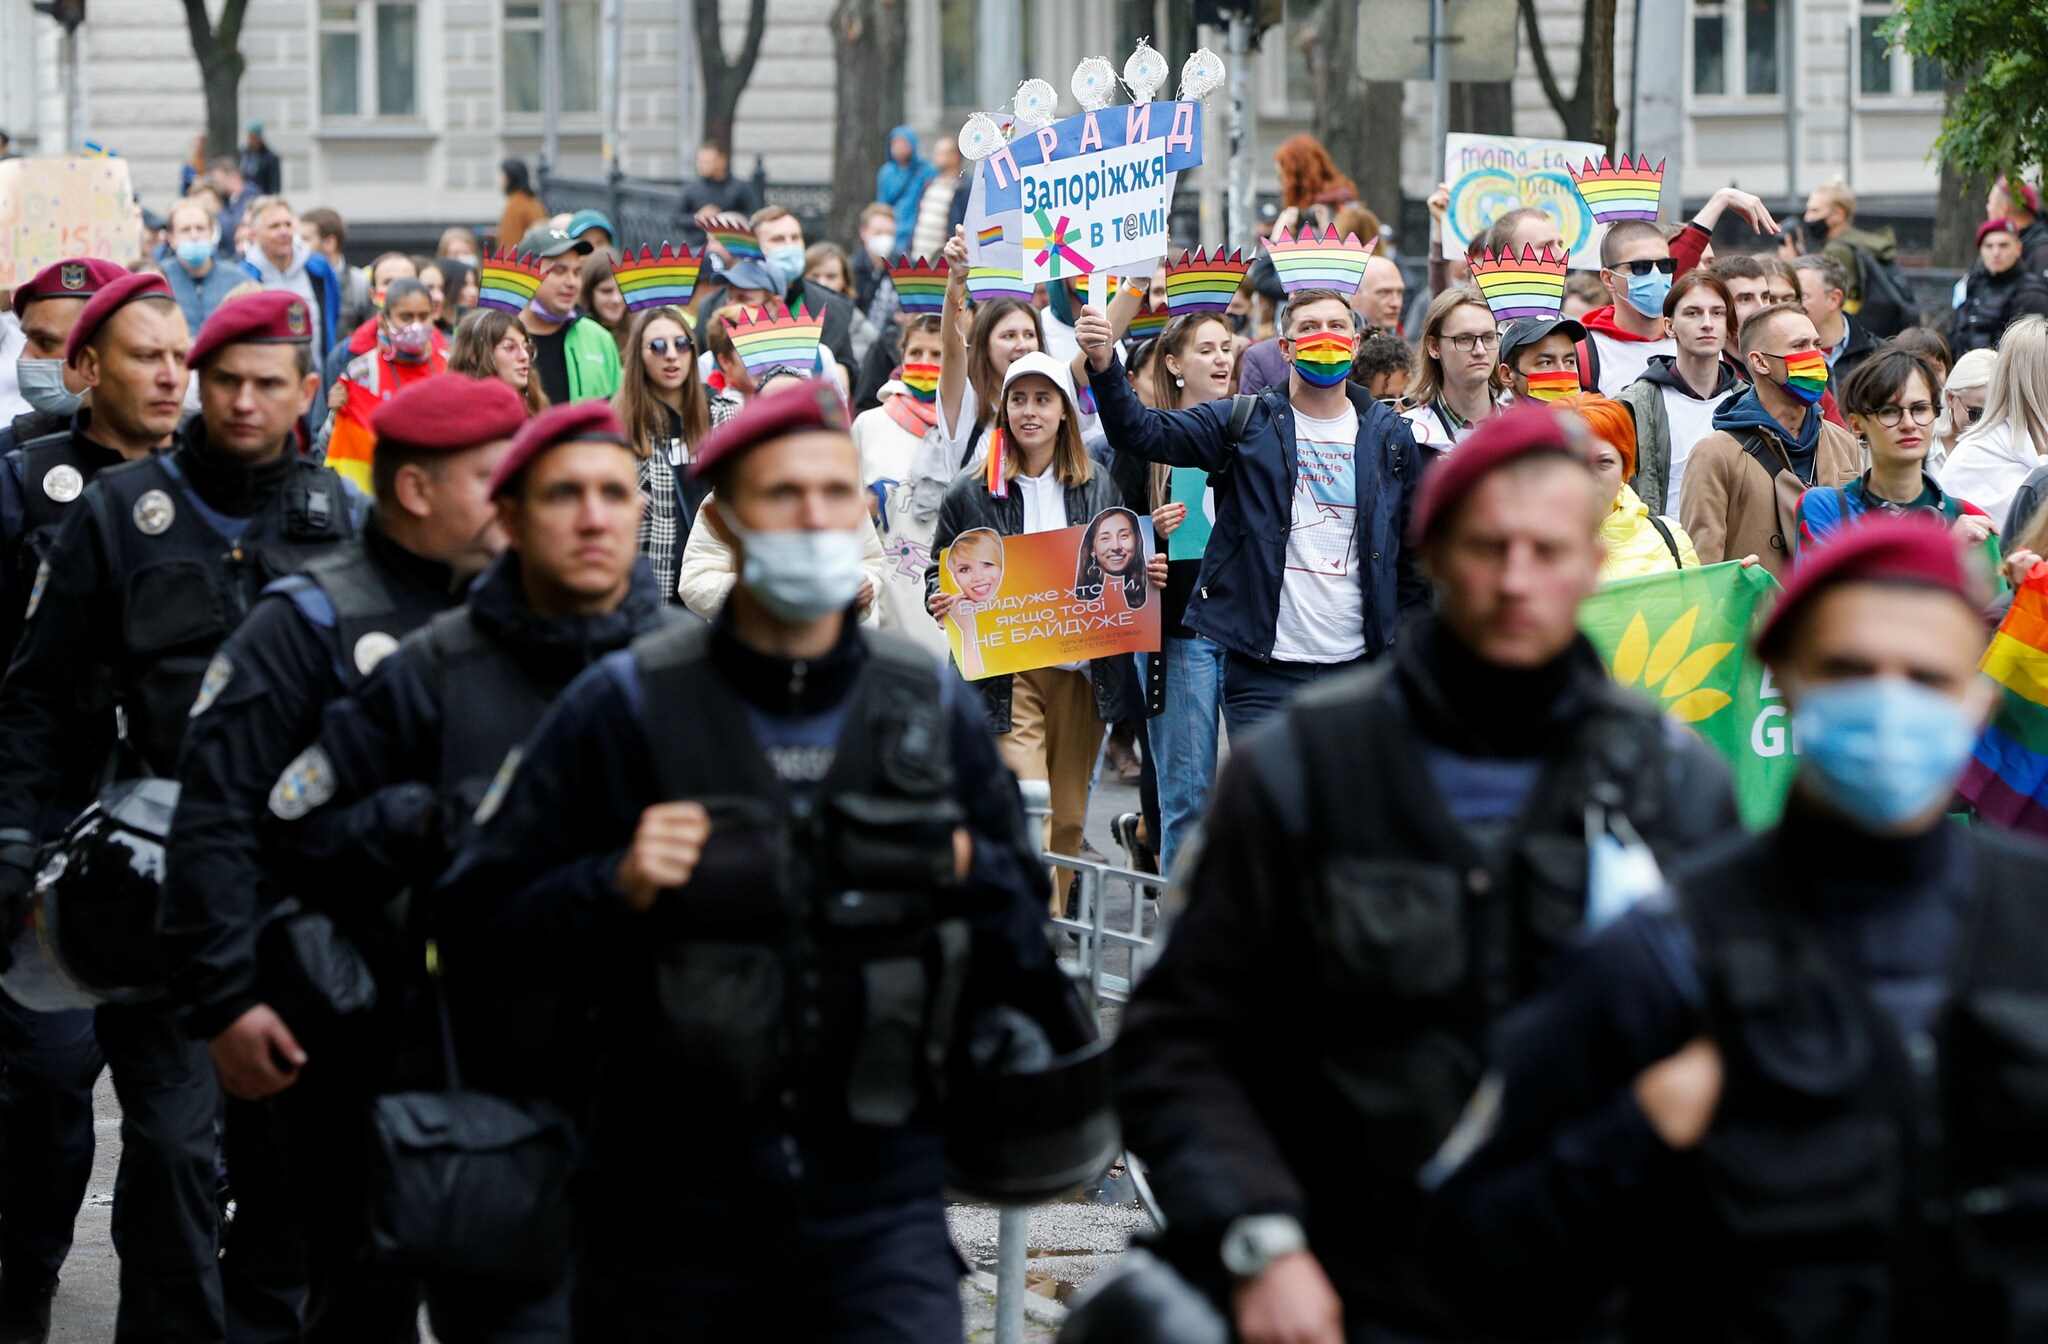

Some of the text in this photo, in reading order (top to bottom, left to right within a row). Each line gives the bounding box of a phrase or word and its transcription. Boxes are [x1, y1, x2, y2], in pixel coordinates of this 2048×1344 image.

[1023, 155, 1164, 214] Запоріжжя
[1090, 197, 1164, 248] в темі
[1297, 448, 1352, 460] orward
[1297, 459, 1343, 472] wards
[1296, 473, 1335, 485] uality
[958, 579, 1141, 616] Байдуже хто ти,
[996, 598, 1106, 627] якщо тобі
[972, 611, 1134, 649] НЕ БАЙДУЖЕ
